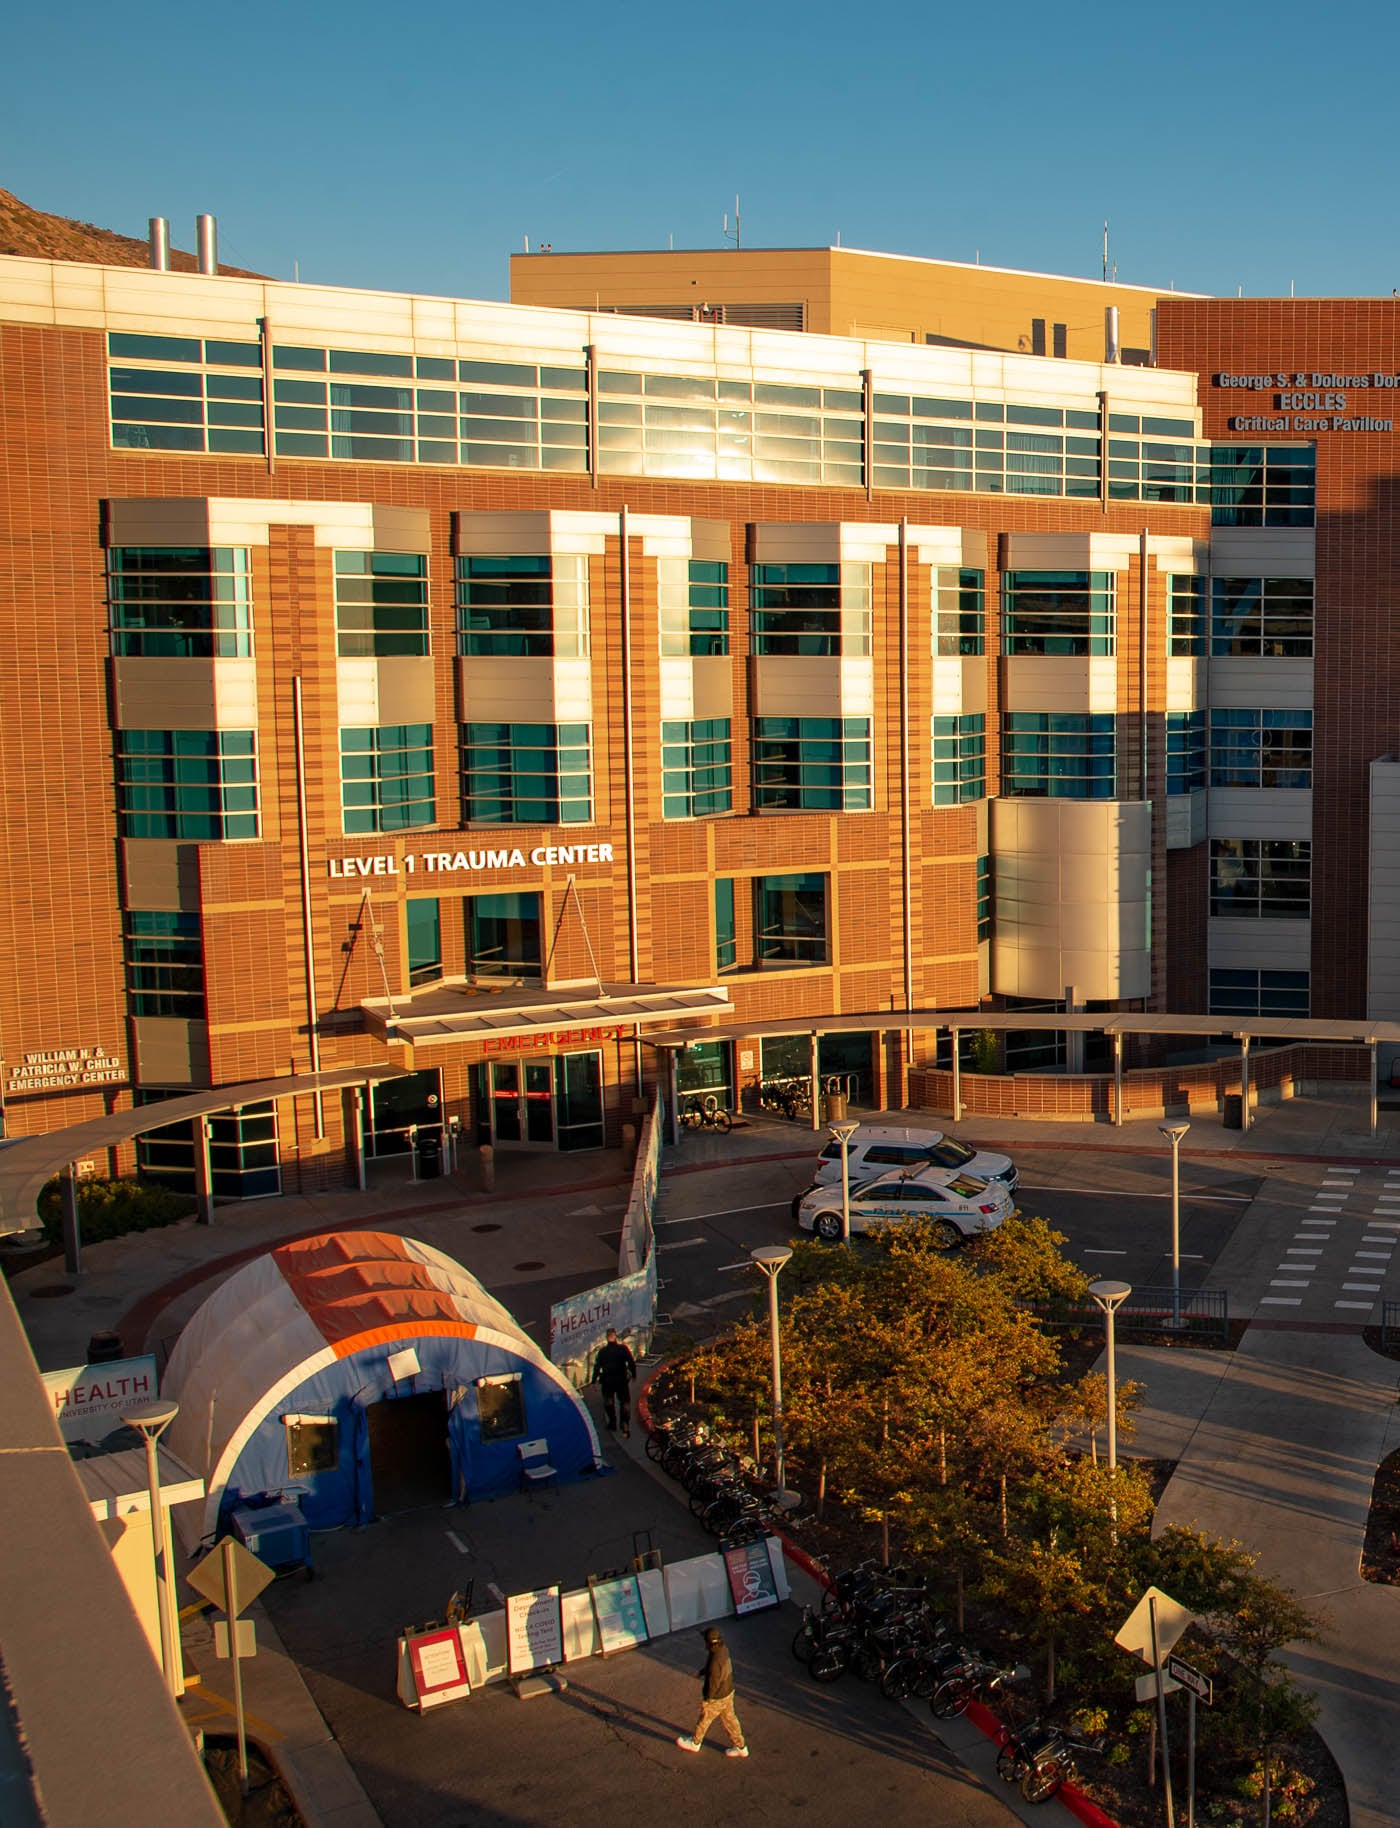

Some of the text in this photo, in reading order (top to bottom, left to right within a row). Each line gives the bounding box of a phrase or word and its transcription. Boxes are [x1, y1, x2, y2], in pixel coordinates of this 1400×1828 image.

[1219, 373, 1272, 390] George
[1277, 373, 1291, 388] S.
[1295, 373, 1306, 388] &
[1312, 373, 1369, 388] Dolores
[1280, 393, 1347, 411] ECCLES
[1235, 416, 1393, 431] Critical Care Pavilion
[329, 843, 614, 878] LEVEL 1 TRAUMA CENTER
[484, 1024, 626, 1053] EMERGENCY
[26, 1048, 104, 1064] WILLIAM H. &
[13, 1057, 120, 1077] PATRICIA W. CHILD
[9, 1070, 125, 1091] EMERGENCY CENTER
[561, 1302, 611, 1335] HEALTH
[55, 1376, 148, 1408] HEALTH
[111, 1401, 124, 1409] OF
